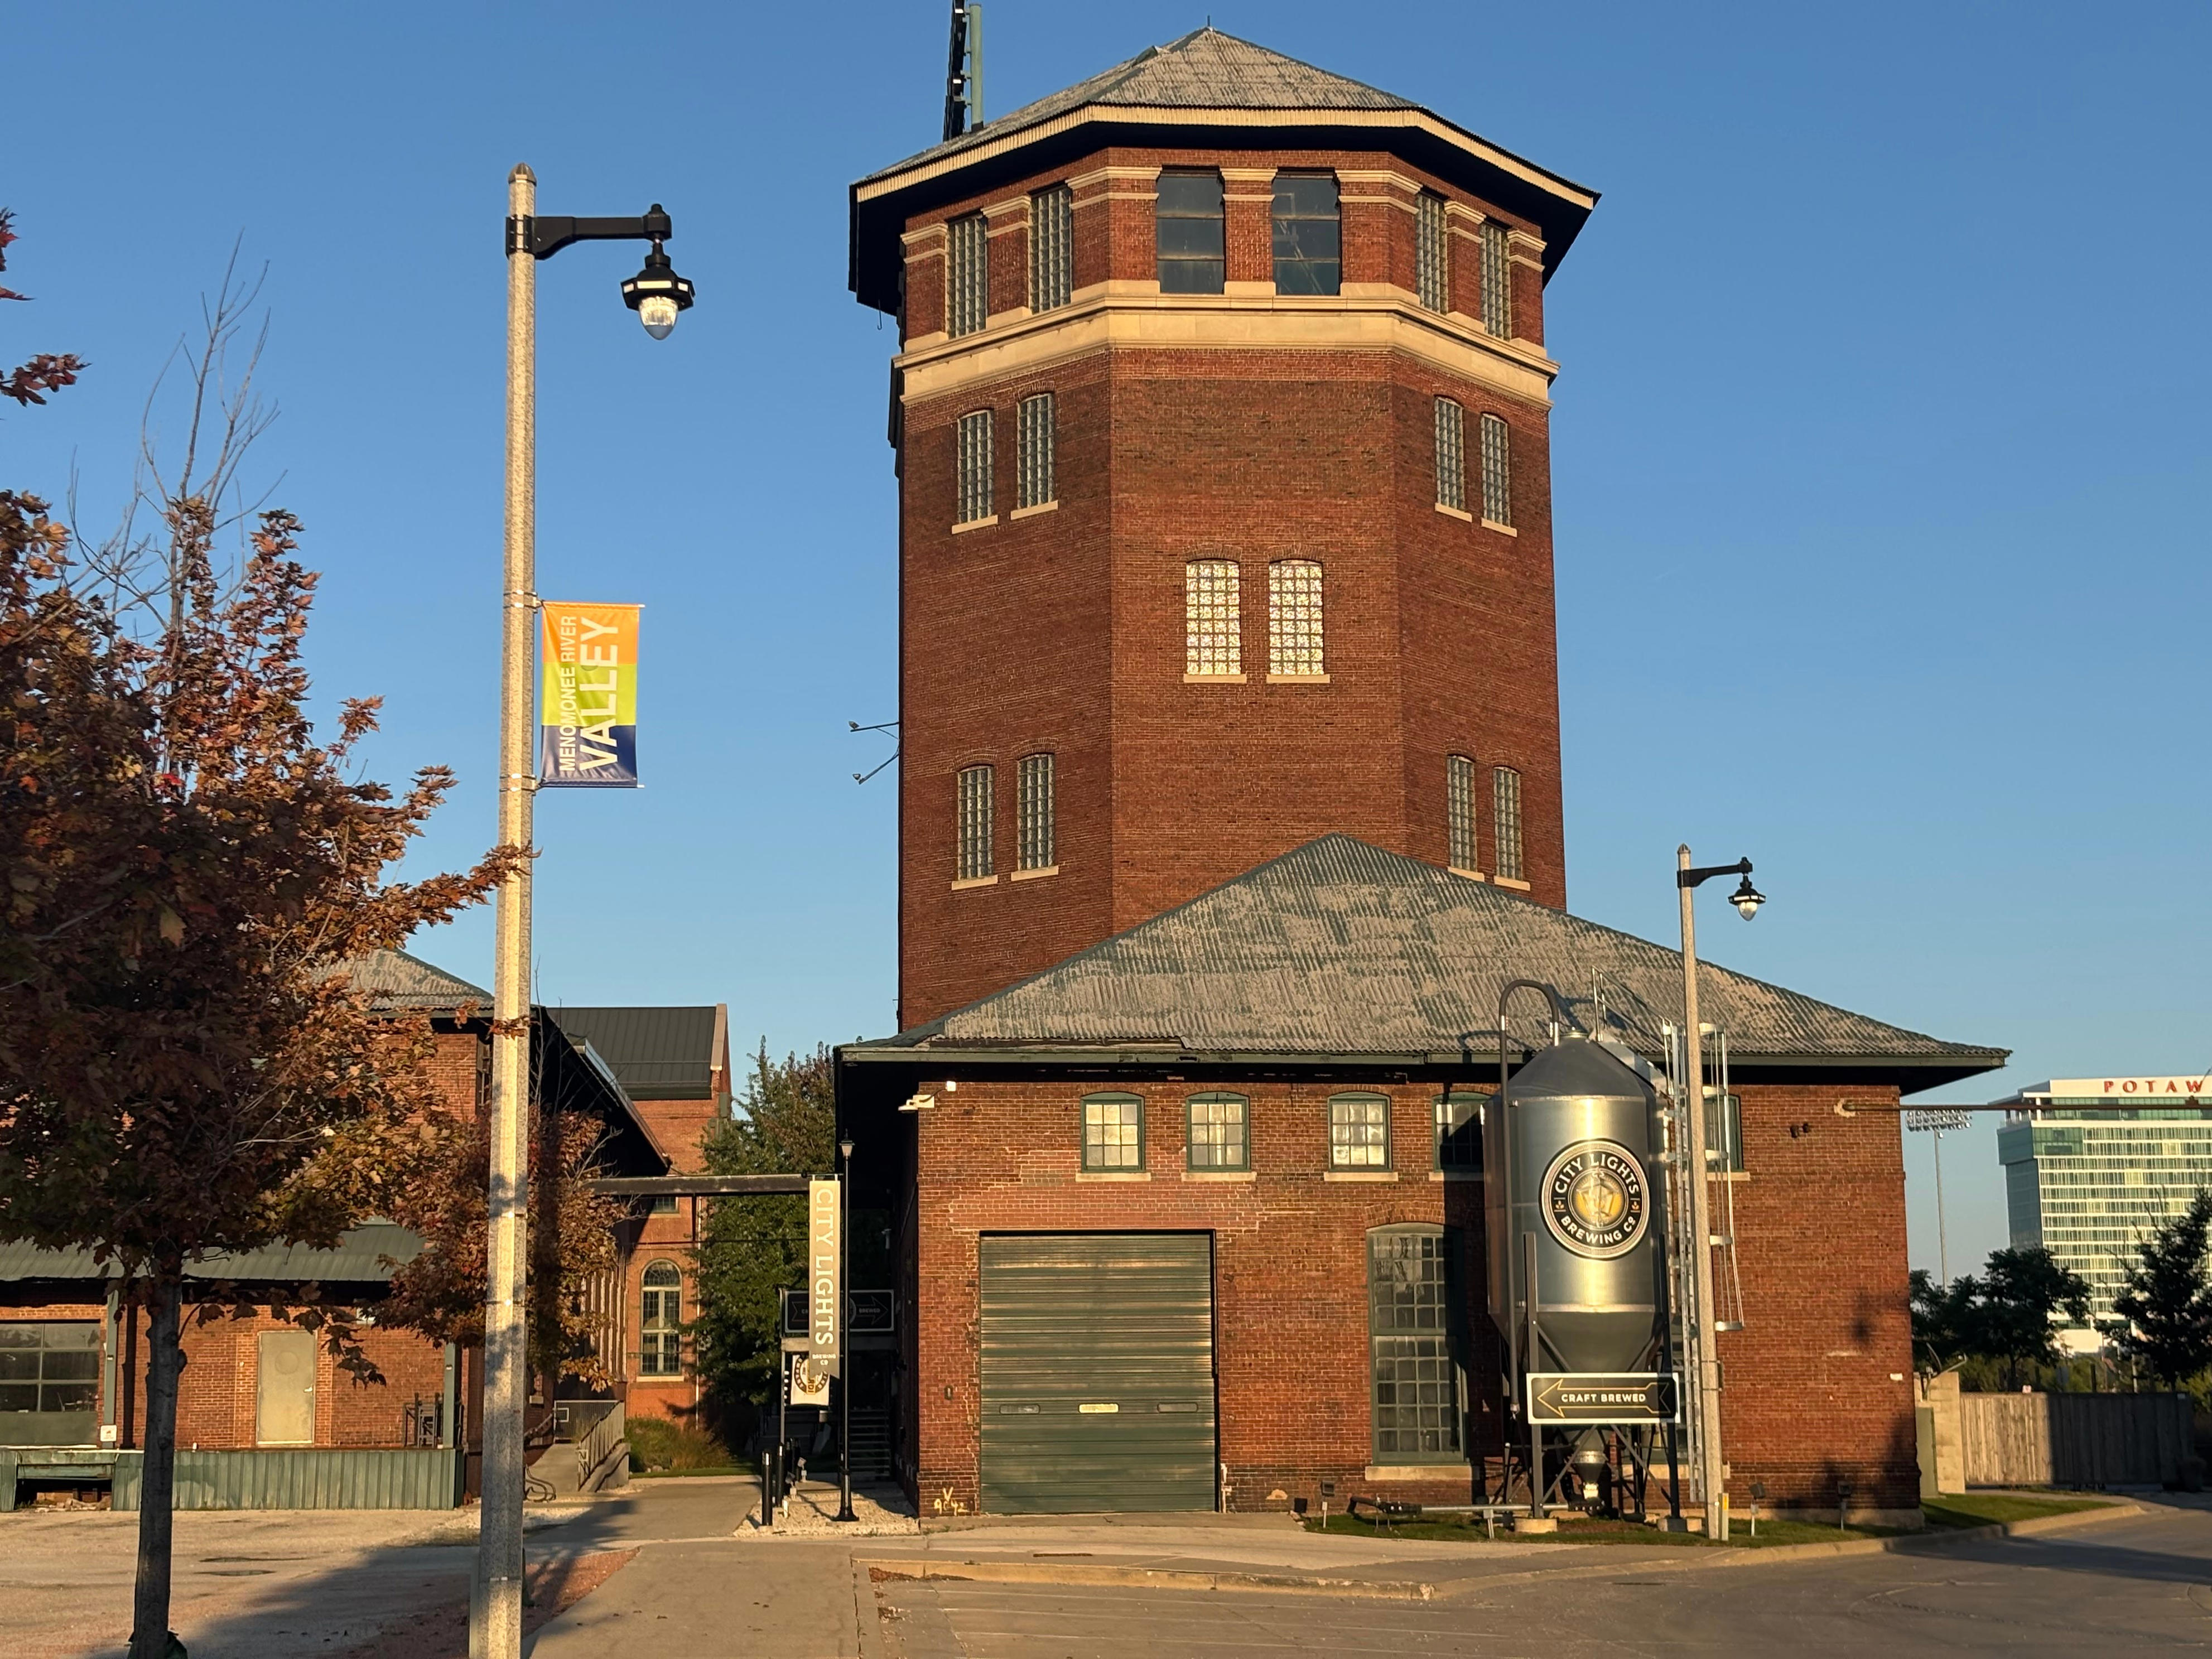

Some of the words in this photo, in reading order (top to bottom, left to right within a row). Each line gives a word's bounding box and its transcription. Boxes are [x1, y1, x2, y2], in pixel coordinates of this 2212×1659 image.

[561, 616, 577, 663] RIVER
[560, 667, 576, 771] MENOMONEE
[580, 617, 618, 771] VALLEY
[1555, 1157, 1583, 1194] CITY
[1589, 1153, 1640, 1194] LIGHTS
[815, 1189, 834, 1247] CITY
[1561, 1215, 1622, 1245] BREWING
[815, 1255, 834, 1345] LIGHTS
[1562, 1393, 1597, 1402] CRAFT
[1601, 1393, 1646, 1402] BREWED
